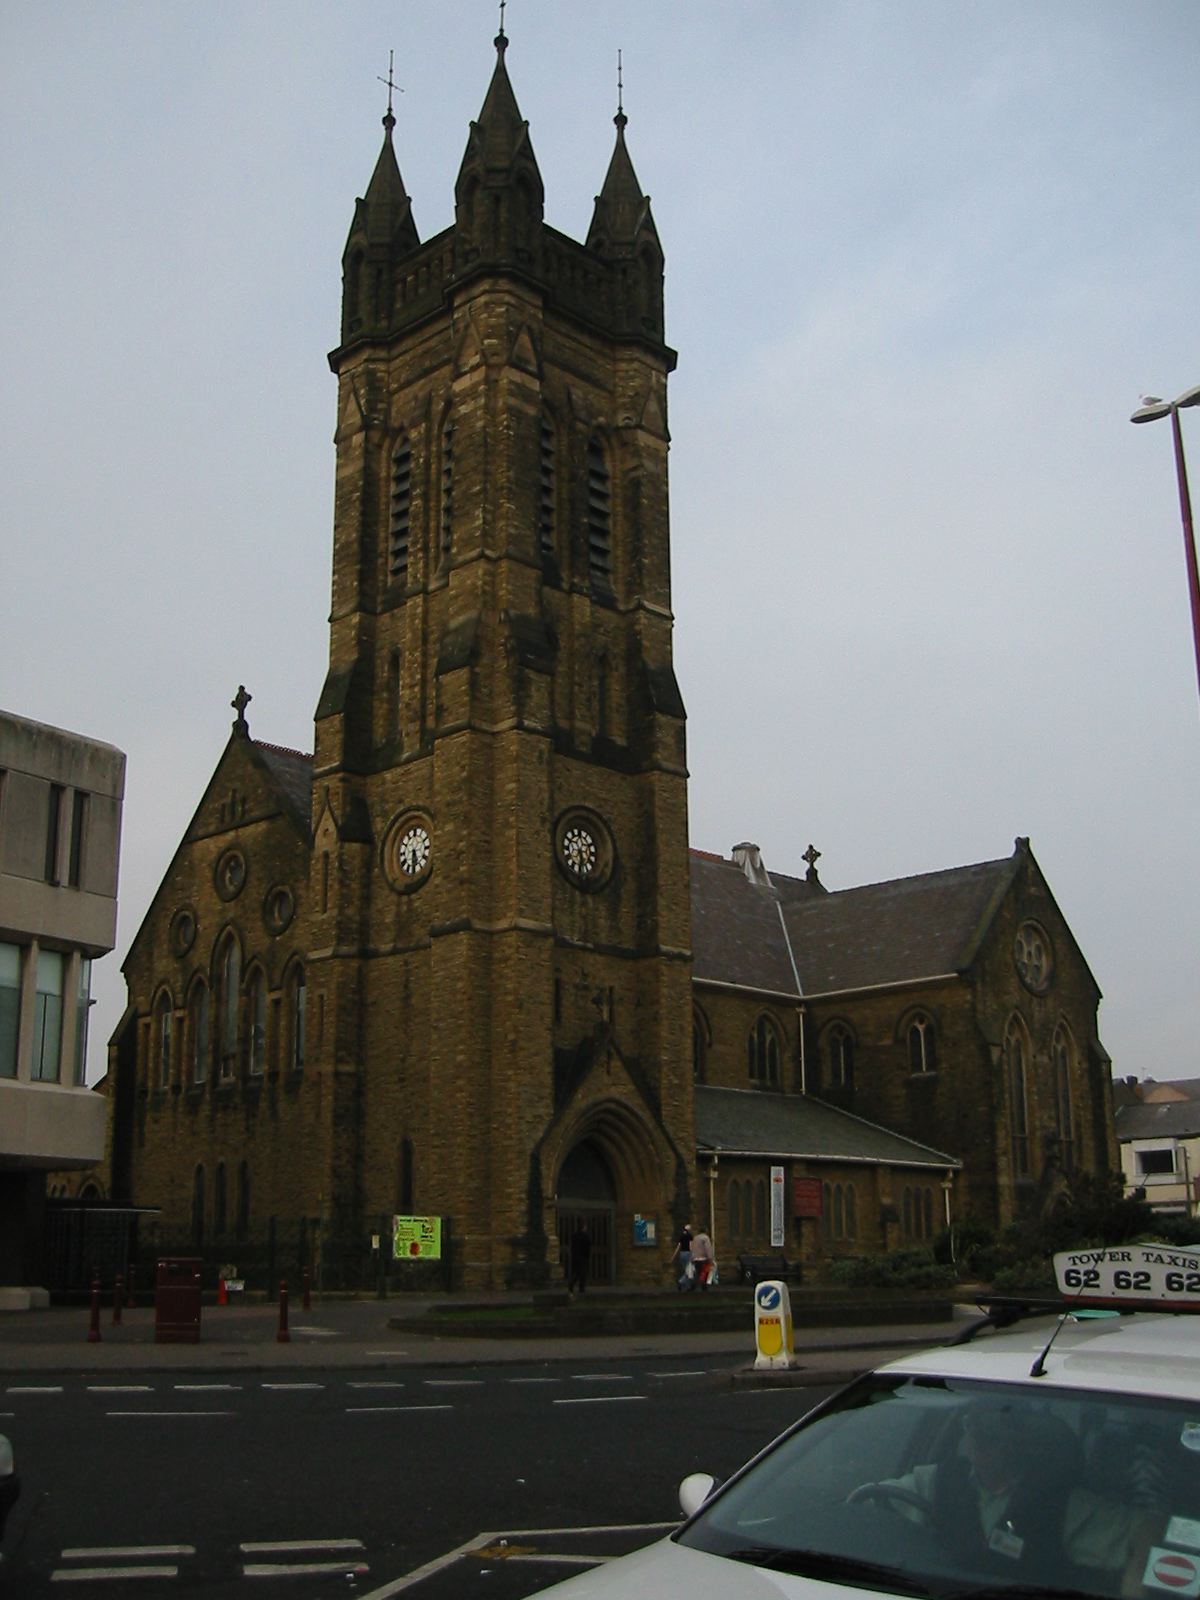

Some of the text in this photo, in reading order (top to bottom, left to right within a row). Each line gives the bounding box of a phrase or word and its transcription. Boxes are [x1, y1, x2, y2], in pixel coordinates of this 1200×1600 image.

[1068, 1251, 1199, 1270] TOWER TAXIS
[1064, 1269, 1200, 1292] 62 62 62
